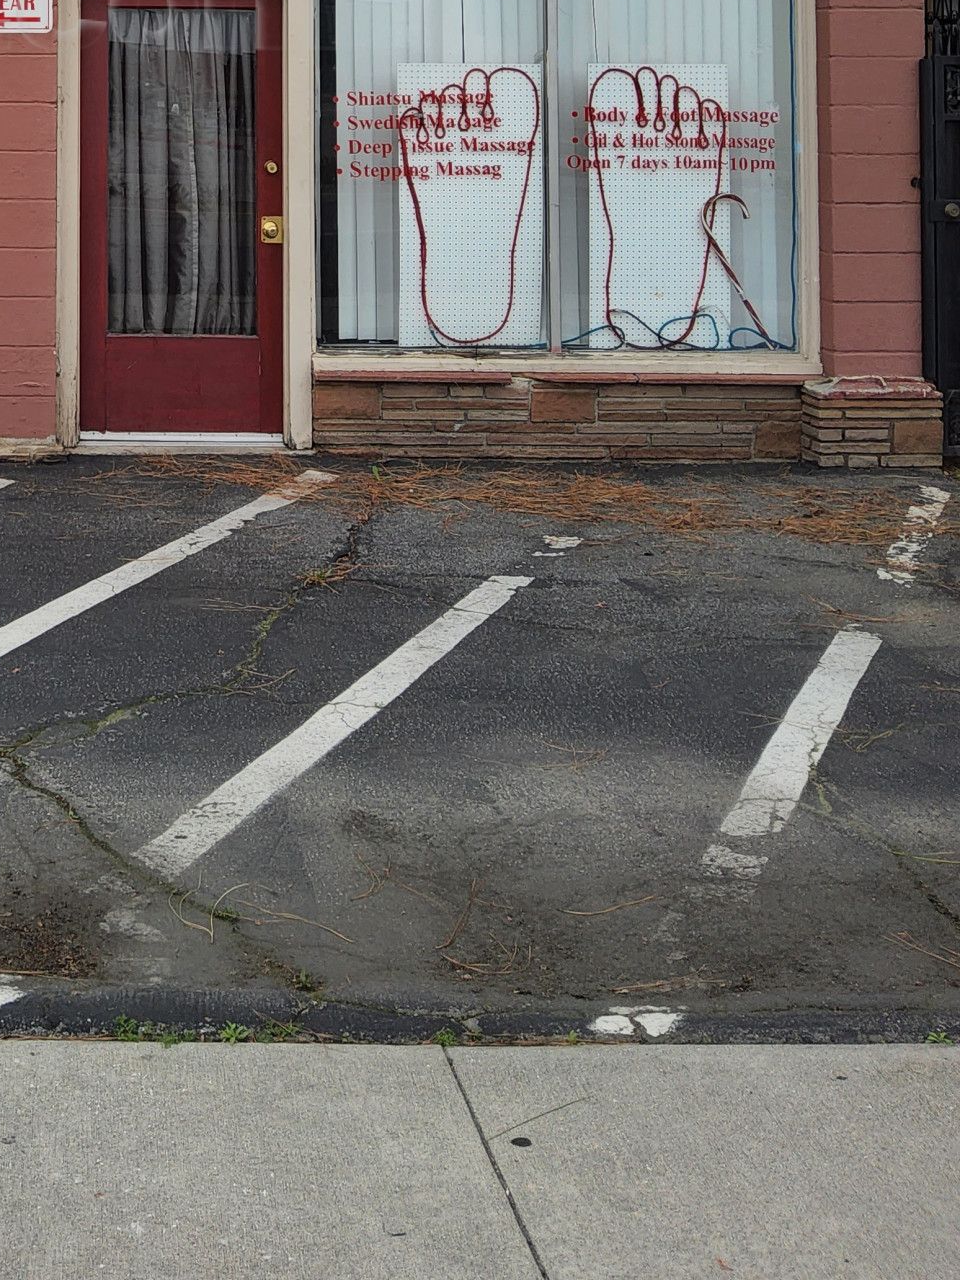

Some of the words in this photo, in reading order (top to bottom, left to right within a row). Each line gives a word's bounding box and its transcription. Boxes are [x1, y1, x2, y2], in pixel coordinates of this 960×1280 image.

[346, 91, 411, 107] Shiatsu
[419, 90, 494, 108] Massage
[348, 115, 421, 131] Swedish
[583, 106, 628, 127] Body
[656, 106, 696, 123] Foot
[703, 107, 778, 128] Massage
[348, 139, 393, 159] Deep
[398, 138, 454, 153] Tissue
[460, 137, 536, 156] Massage
[584, 133, 607, 149] Oil
[612, 134, 625, 148] &
[632, 133, 660, 148] Hot
[665, 133, 706, 149] Stone
[712, 133, 776, 153] Massage
[350, 161, 431, 181] Stepping
[436, 161, 502, 180] Massag
[566, 155, 611, 170] Open
[616, 155, 626, 169] 7
[631, 155, 669, 171] days
